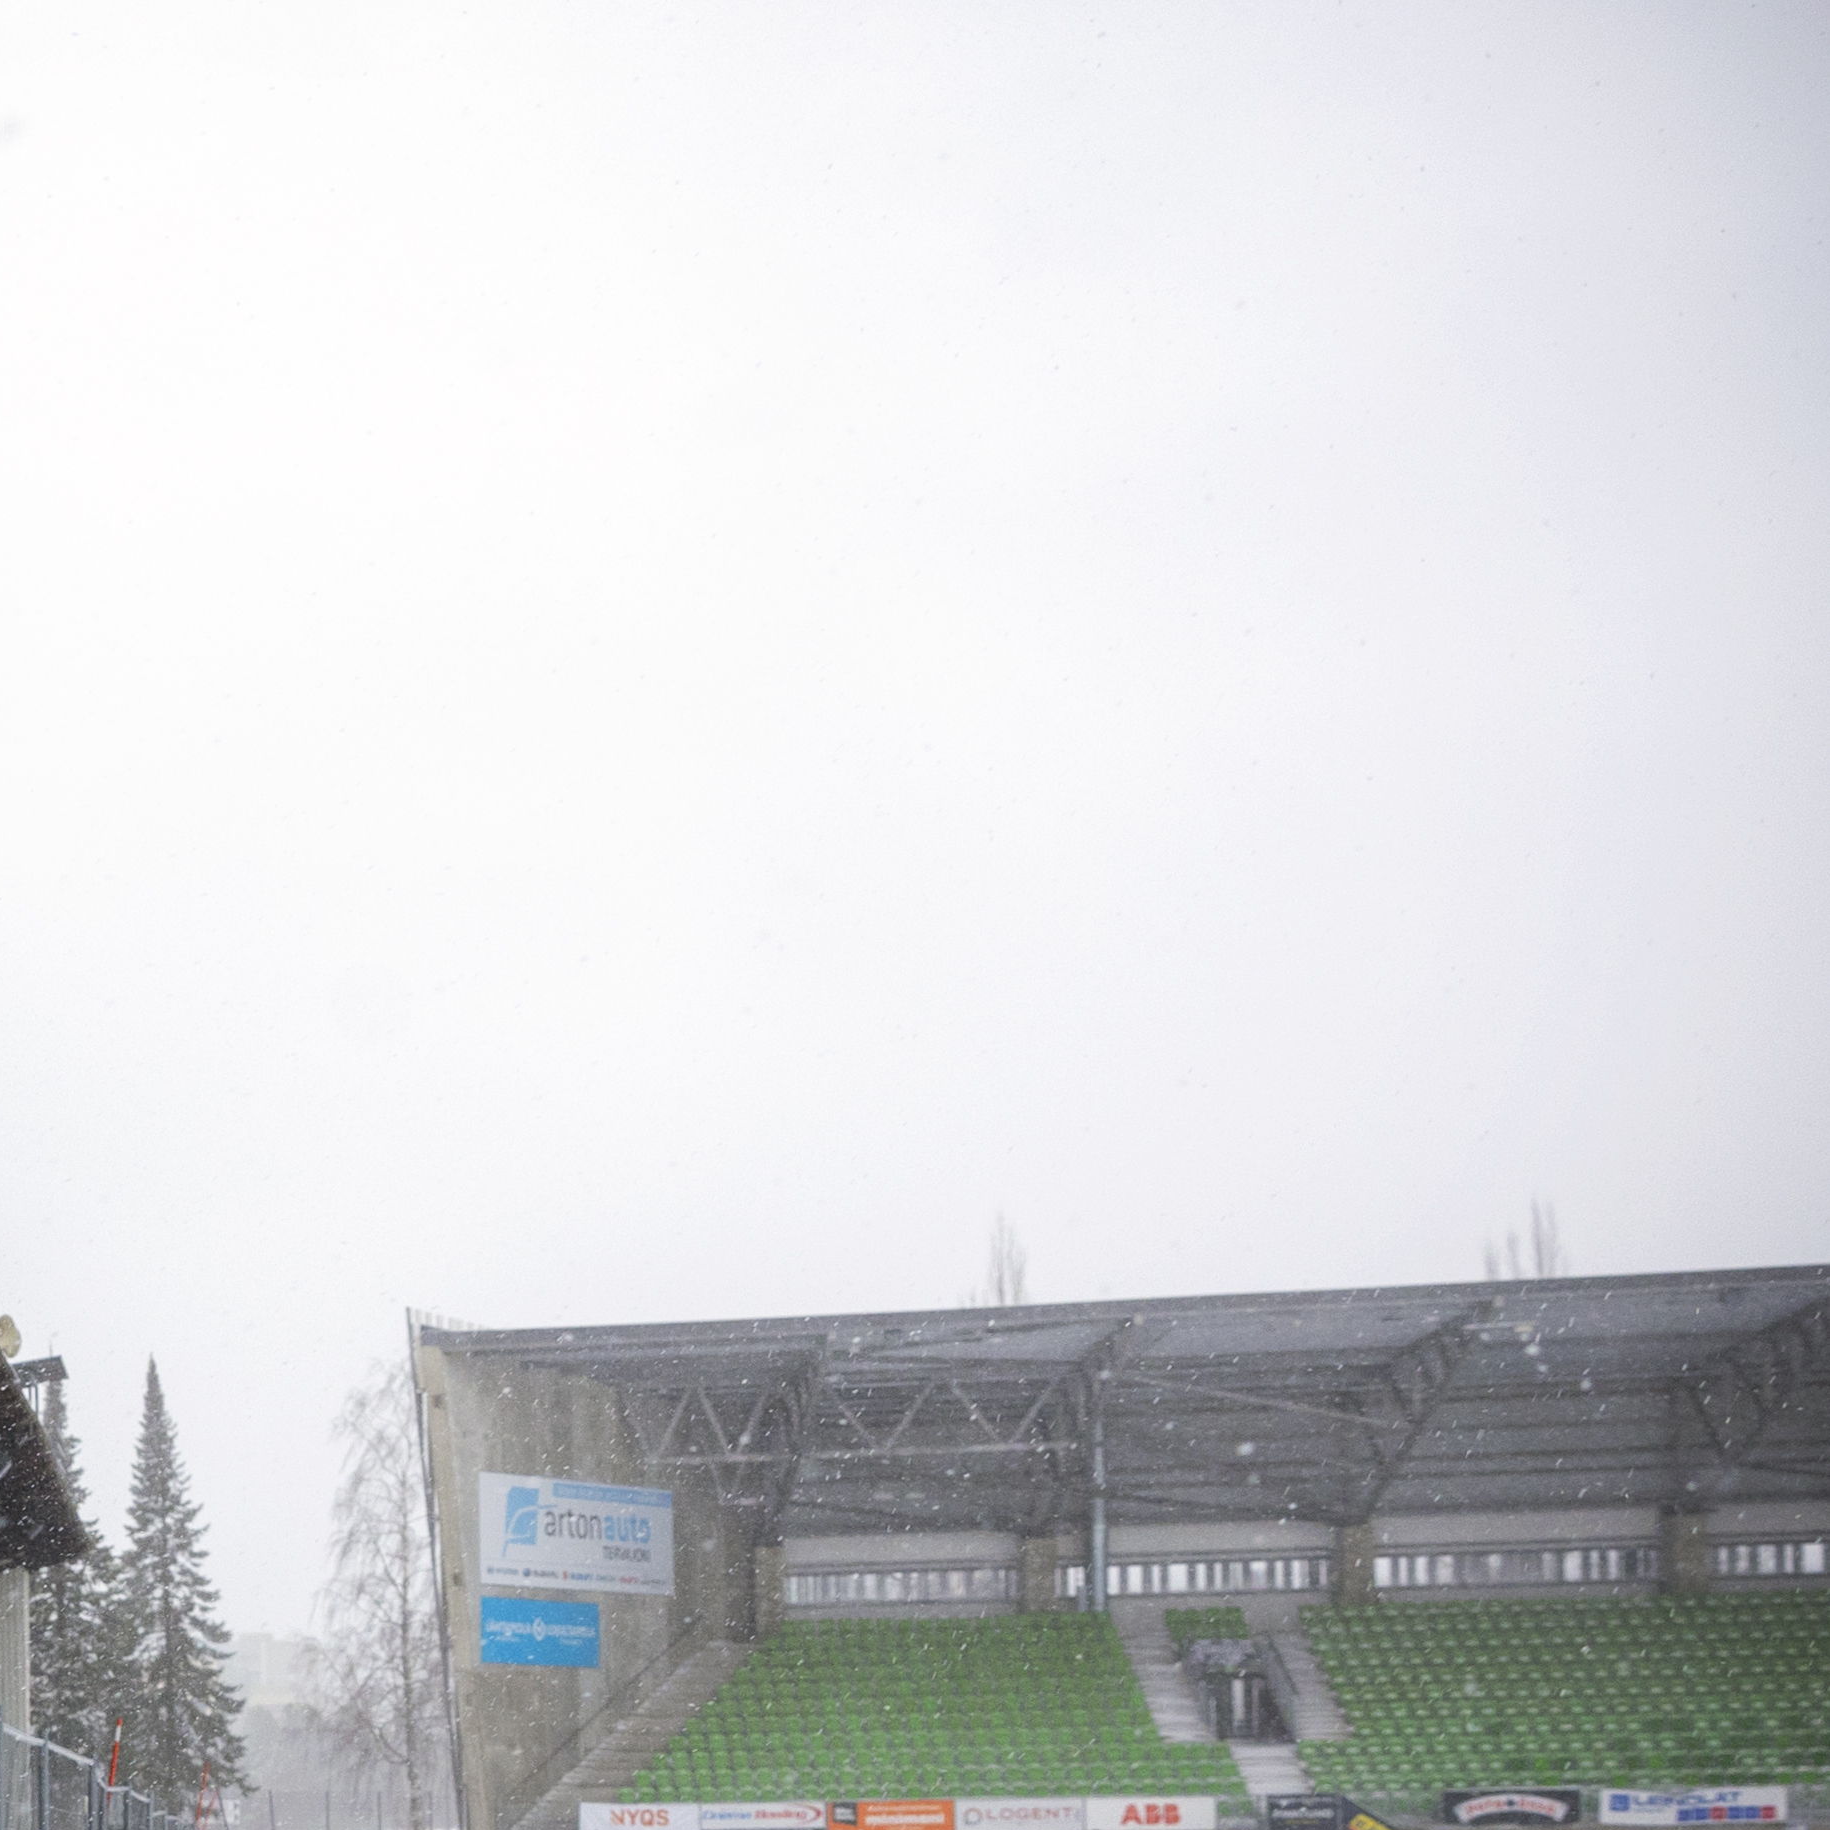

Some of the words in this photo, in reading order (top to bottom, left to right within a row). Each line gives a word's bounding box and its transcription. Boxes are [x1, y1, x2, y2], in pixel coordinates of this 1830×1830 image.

[544, 1509, 651, 1543] artonauto
[609, 1808, 670, 1827] NYQS
[985, 1806, 1073, 1821] LOGENT
[1121, 1803, 1181, 1825] ABB
